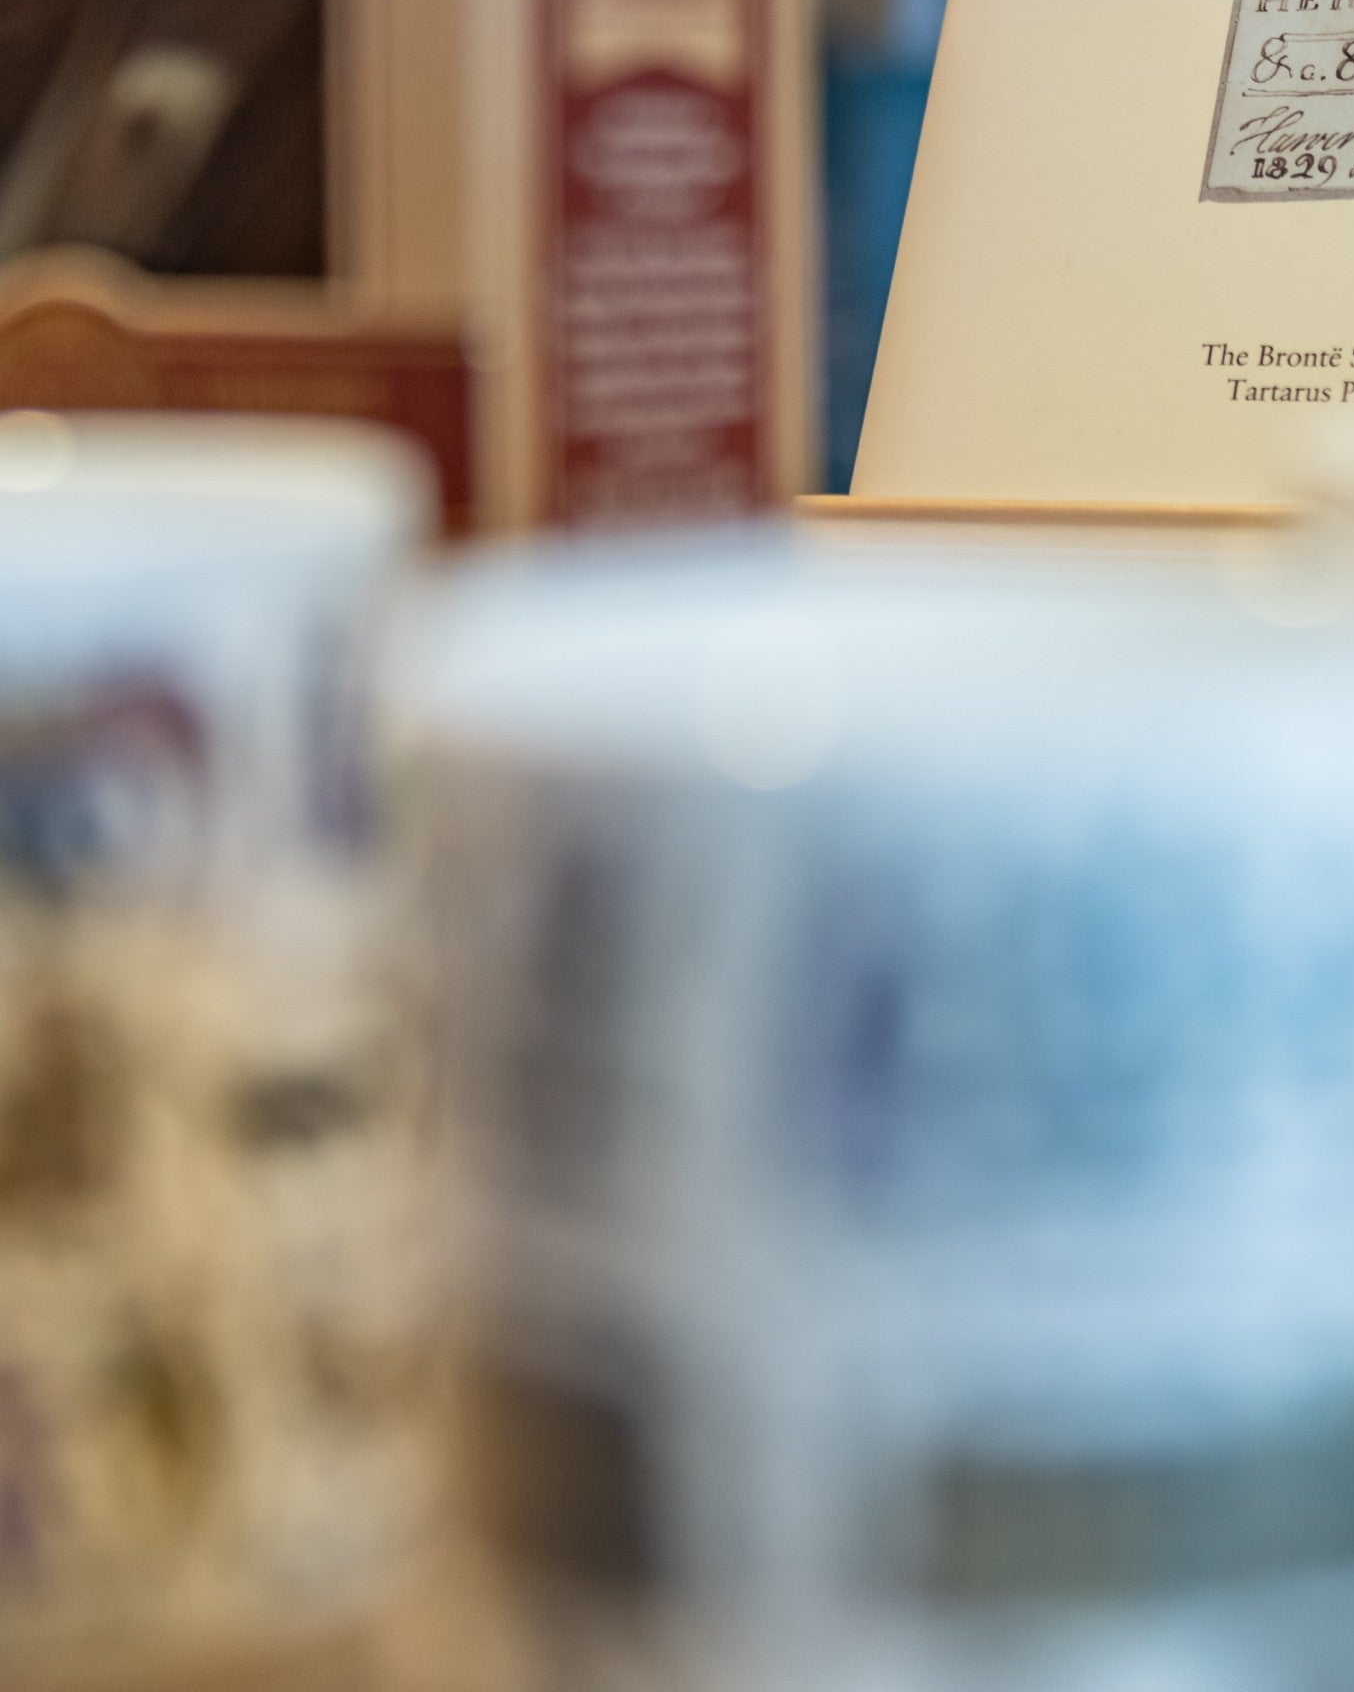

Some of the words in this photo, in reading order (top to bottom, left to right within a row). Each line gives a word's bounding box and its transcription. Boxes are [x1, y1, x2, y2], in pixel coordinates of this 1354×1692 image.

[1251, 153, 1337, 186] 1829
[1202, 343, 1249, 367] The
[1258, 345, 1343, 368] Brontë
[1227, 378, 1331, 403] Tartarus
